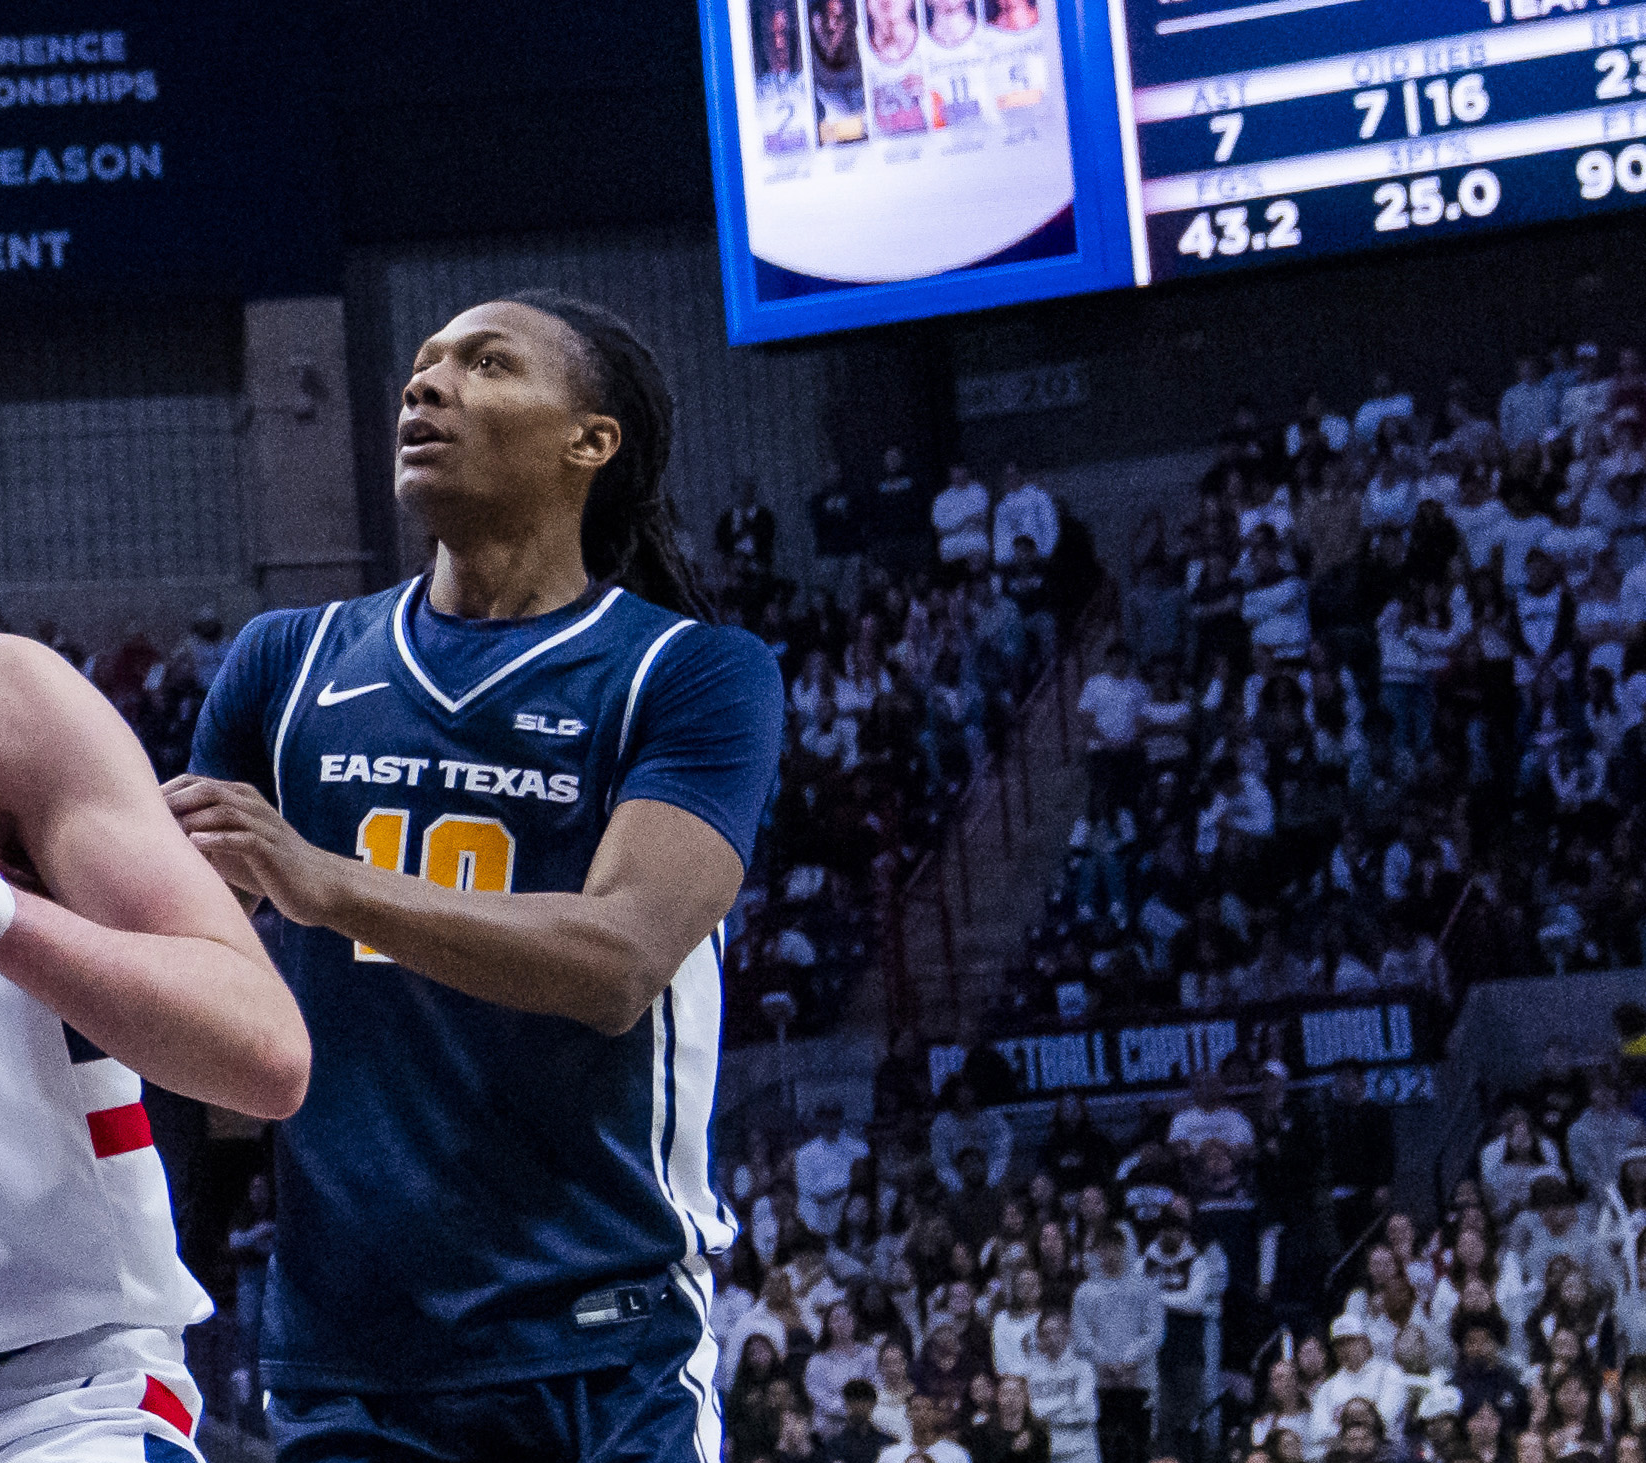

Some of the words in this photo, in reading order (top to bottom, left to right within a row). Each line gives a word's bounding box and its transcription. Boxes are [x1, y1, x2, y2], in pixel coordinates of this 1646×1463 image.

[1209, 112, 1244, 163] 7
[1177, 199, 1303, 260] 43.2
[1373, 168, 1502, 232] 25.0
[319, 752, 431, 787] EAST
[438, 759, 581, 805] TEXAS
